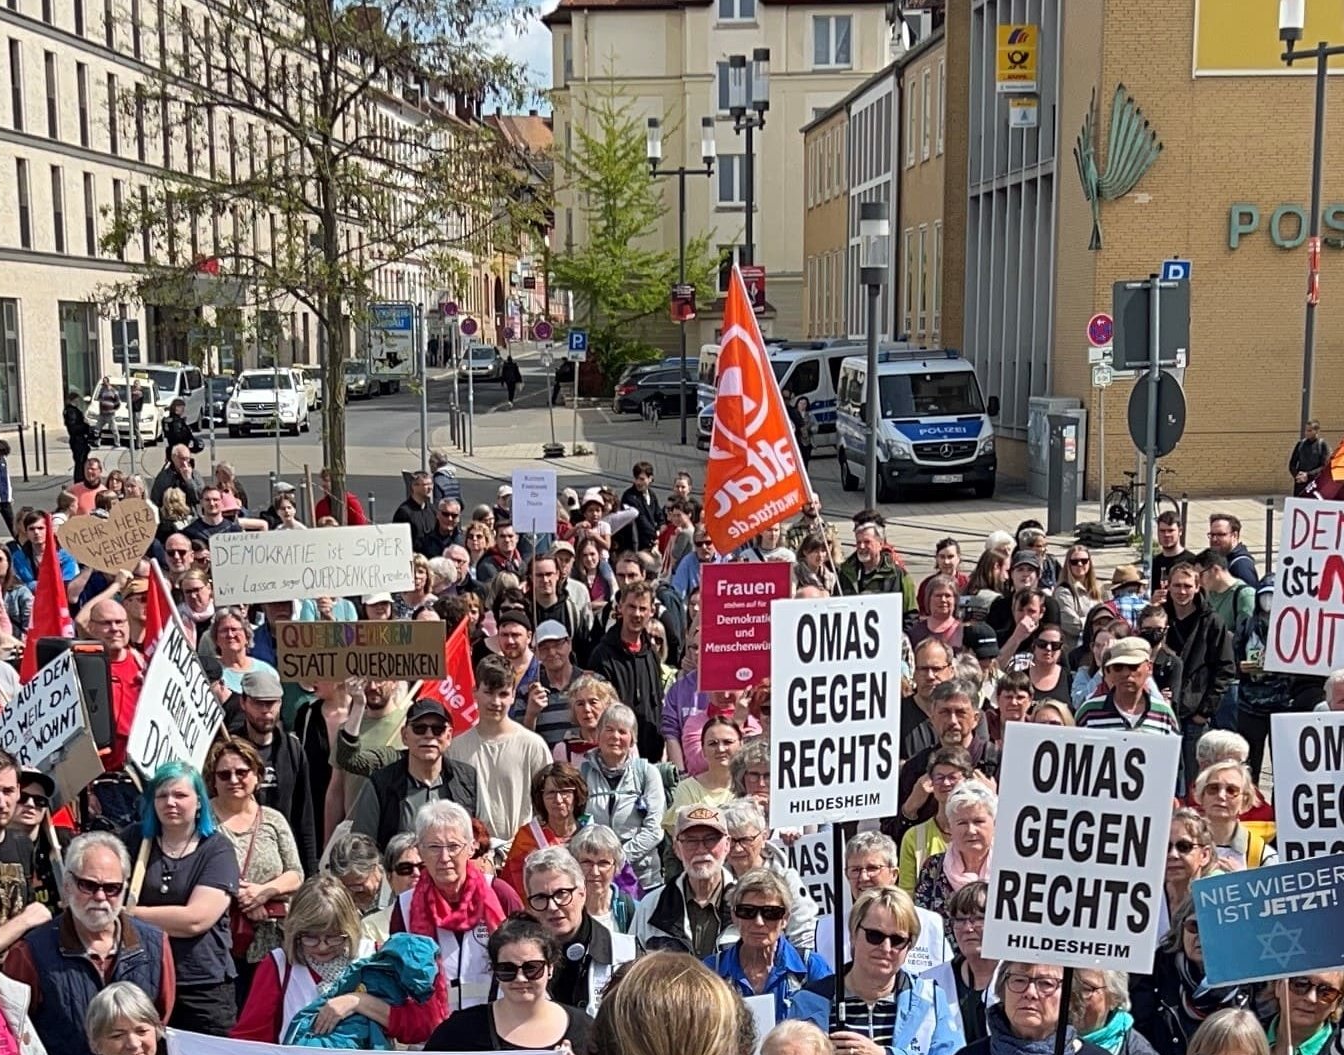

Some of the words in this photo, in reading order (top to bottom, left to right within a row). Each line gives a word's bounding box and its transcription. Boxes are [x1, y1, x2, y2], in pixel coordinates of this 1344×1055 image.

[572, 333, 583, 348] P
[919, 426, 967, 436] POLIZEI
[65, 523, 108, 548] MEHR
[114, 507, 153, 531] HERZ
[87, 526, 151, 558] WENIGER
[103, 546, 143, 568] HETZE
[215, 543, 317, 567] DEMOKRATIE
[328, 542, 345, 560] ist
[352, 537, 405, 558] SUPER
[302, 563, 383, 590] QUERDENKER
[717, 580, 776, 596] Frauen
[1282, 556, 1320, 598] ist
[705, 640, 771, 653] Menschenwür
[735, 627, 755, 638] und
[796, 609, 880, 664] OMAS
[283, 652, 338, 678] STATT
[345, 651, 440, 677] QUERDENKEN
[17, 676, 40, 711] AUF
[43, 656, 72, 687] DEN
[787, 670, 888, 727] GEGEN
[17, 707, 46, 735] WEIL
[49, 683, 72, 709] DA
[35, 701, 80, 751] WOHNT
[141, 719, 180, 768] DÖN
[778, 731, 893, 790] RECHTS
[1032, 740, 1147, 801] OMAS
[790, 792, 881, 813] HILDESHEIM
[1014, 805, 1151, 868] GEGEN
[994, 869, 1152, 934] RECHTS
[1199, 884, 1240, 907] NIE
[1216, 902, 1253, 925] IST
[1259, 888, 1338, 918] JETZT!
[1007, 934, 1130, 959] HILDESHEIM
